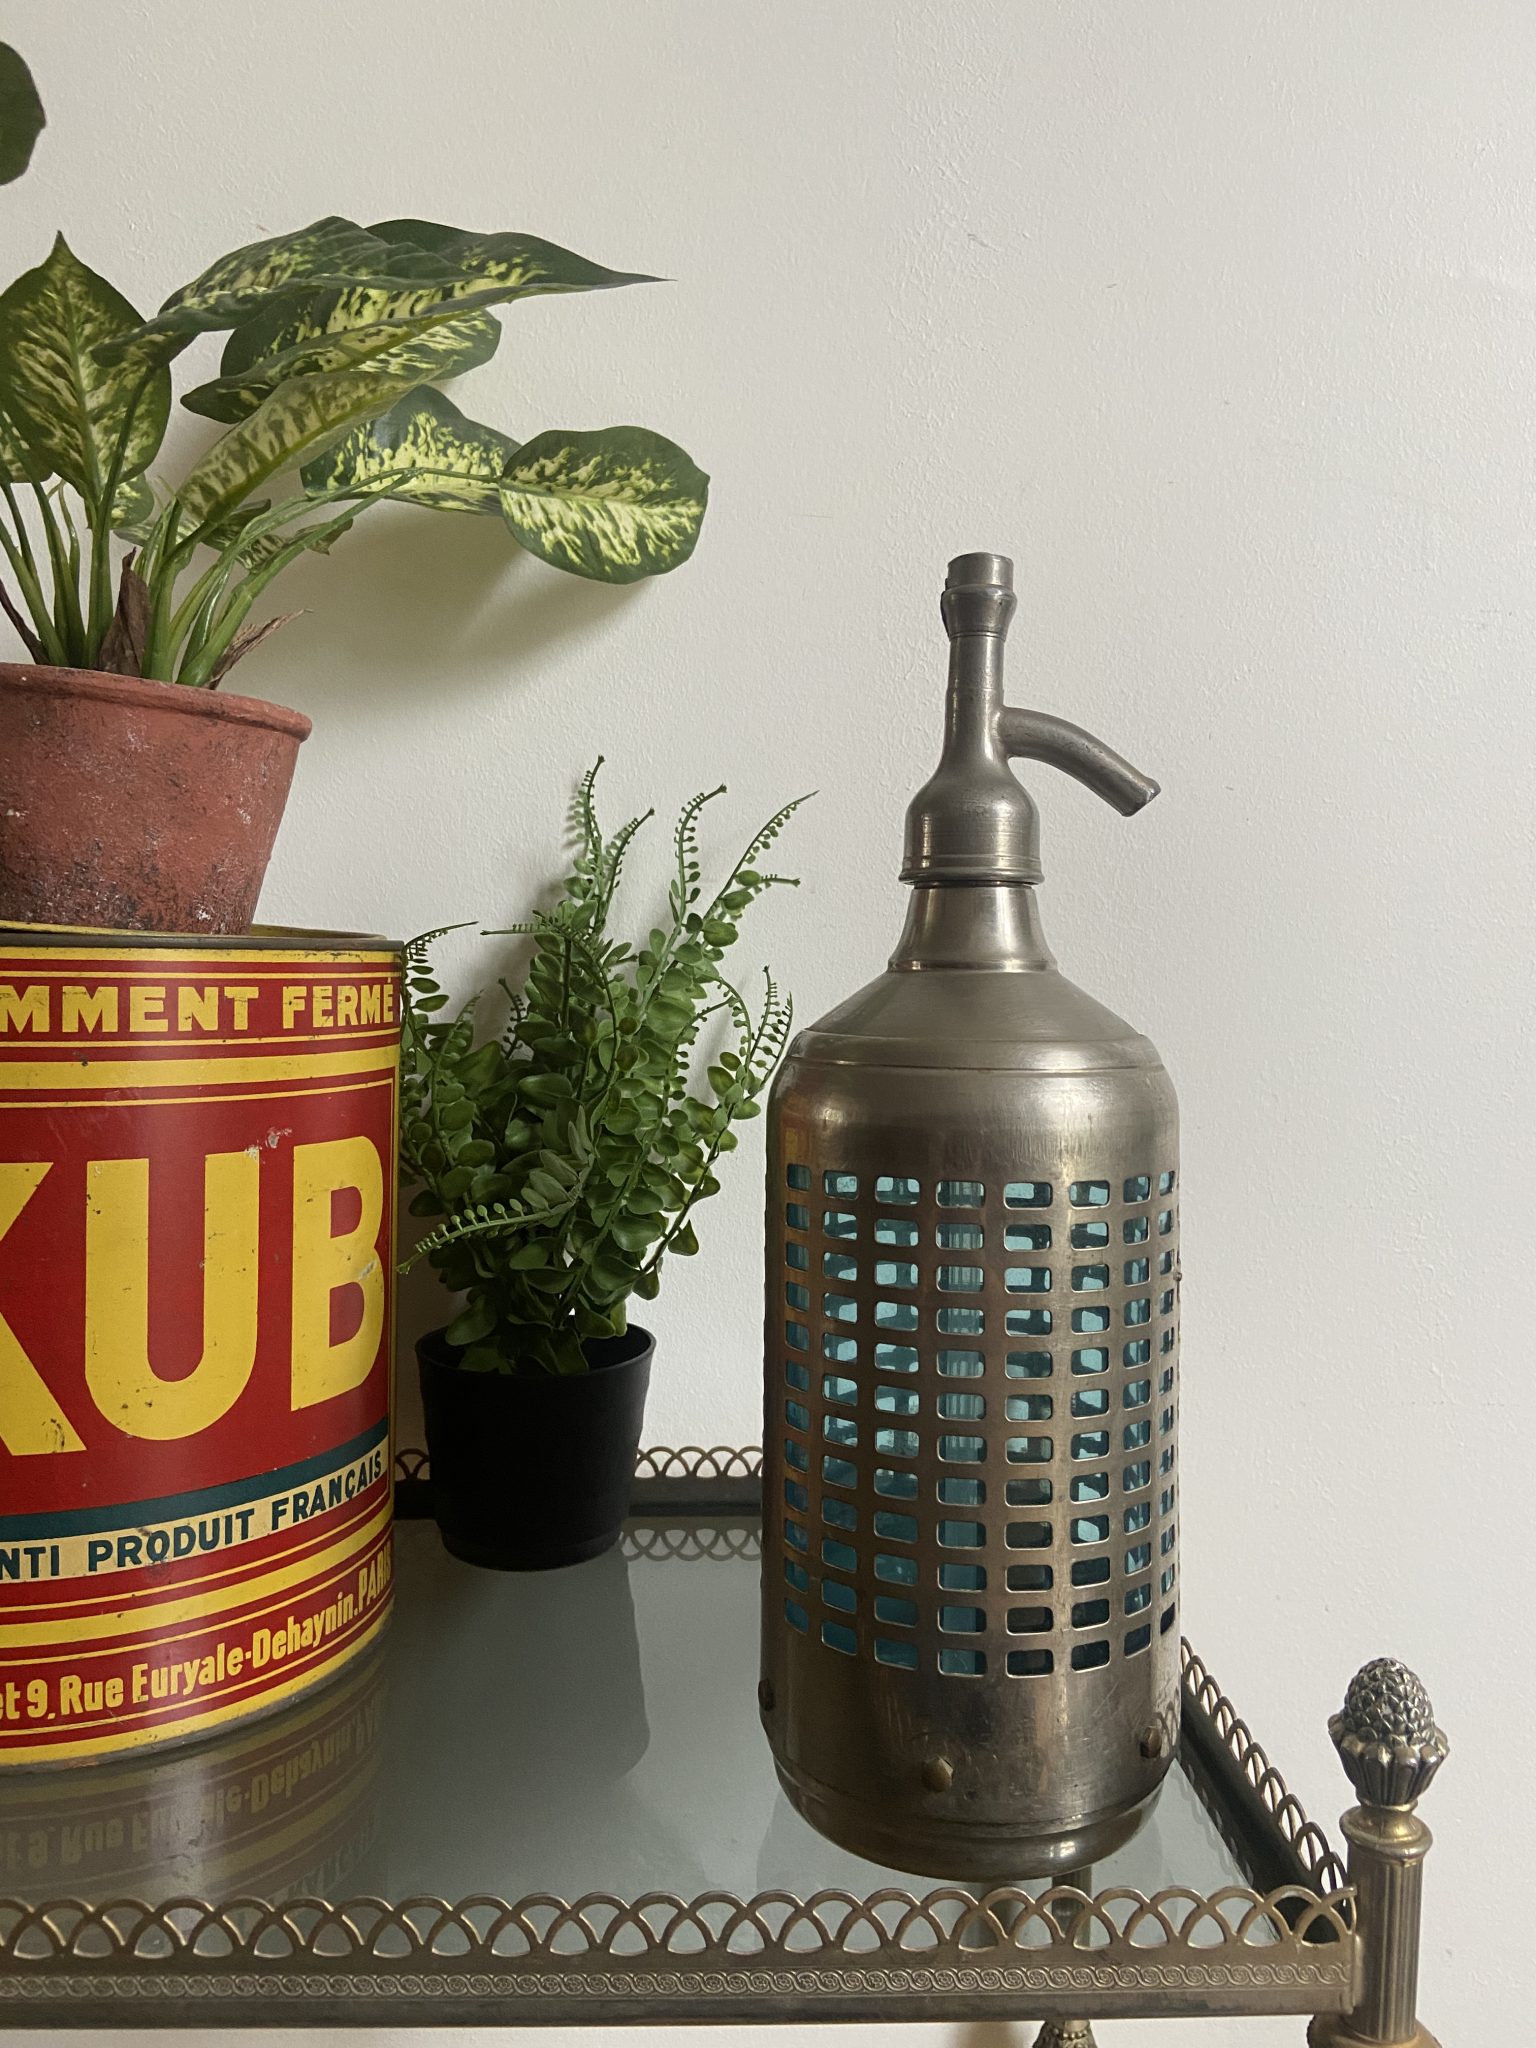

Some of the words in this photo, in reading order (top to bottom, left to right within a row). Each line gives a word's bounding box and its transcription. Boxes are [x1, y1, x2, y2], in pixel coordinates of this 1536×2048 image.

[0, 985, 259, 1034] MMENT
[282, 977, 394, 1030] FERMÉ
[0, 1545, 60, 1579] NTI
[88, 1508, 255, 1572] PRODUIT
[271, 1450, 382, 1530] FRANÇAIS
[0, 1682, 21, 1720] t
[60, 1674, 124, 1716] Rue
